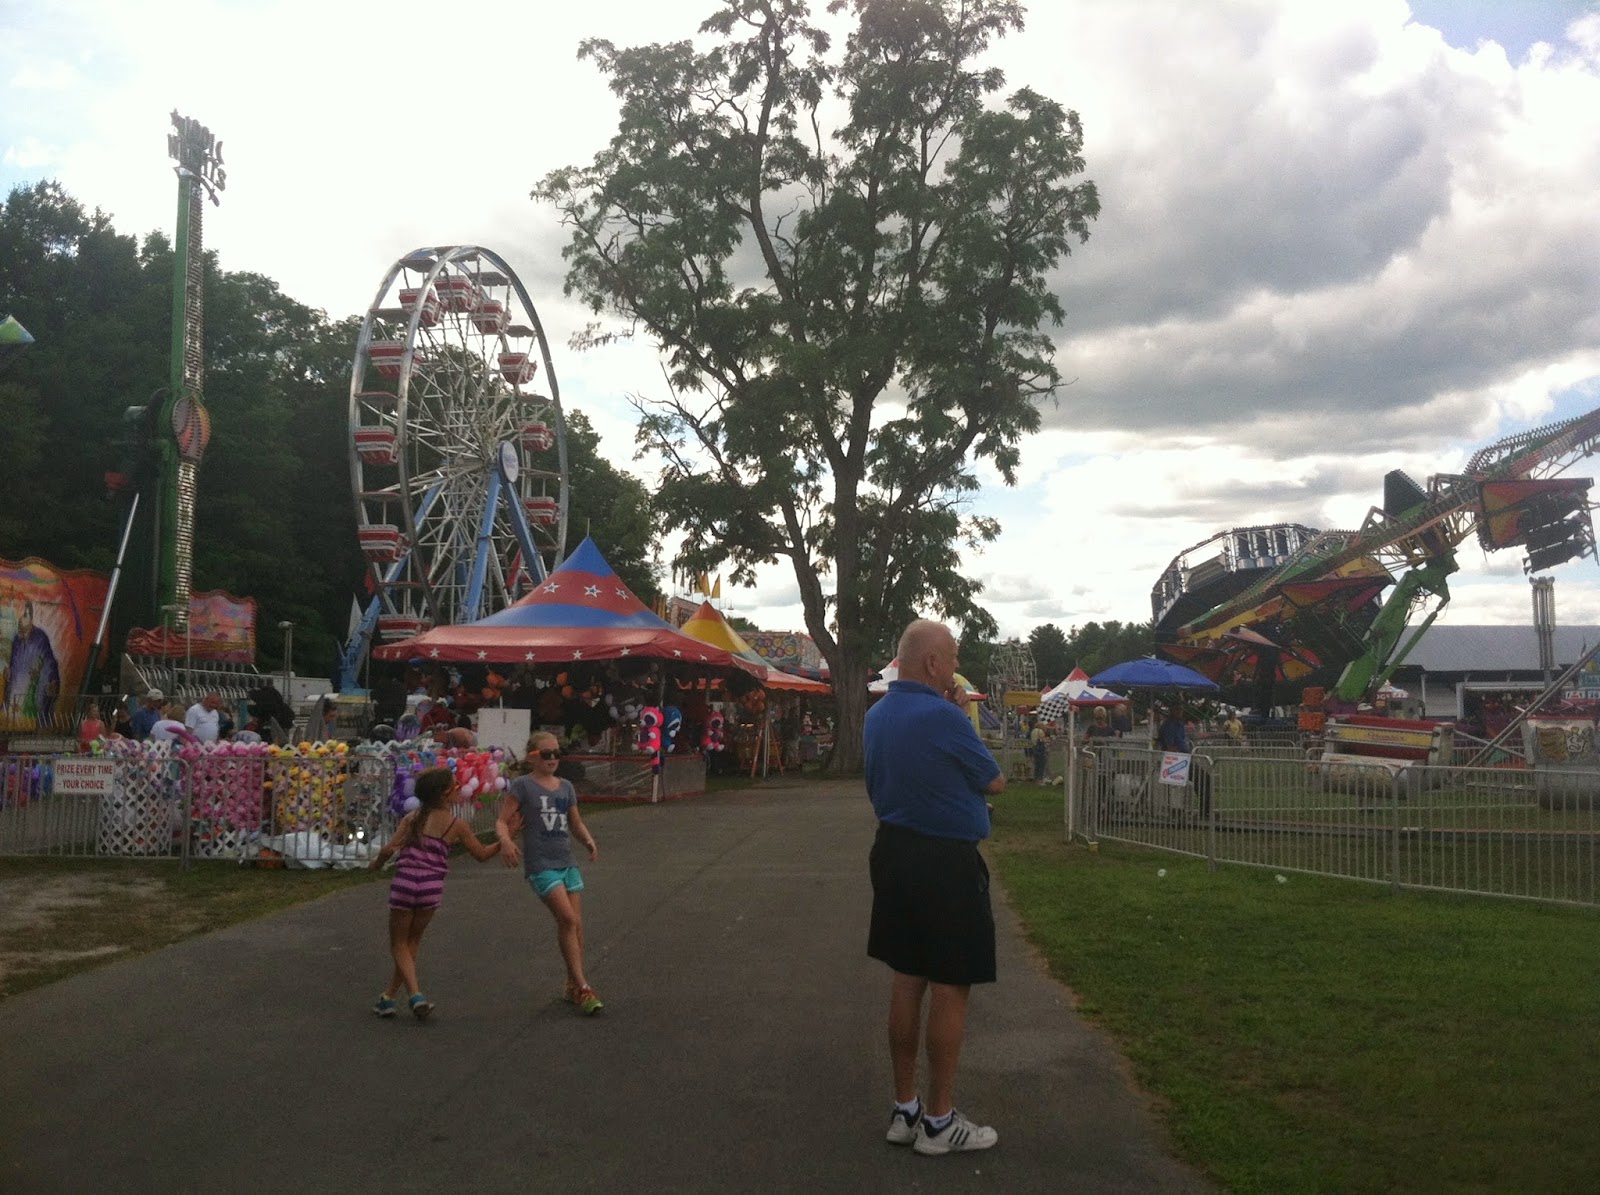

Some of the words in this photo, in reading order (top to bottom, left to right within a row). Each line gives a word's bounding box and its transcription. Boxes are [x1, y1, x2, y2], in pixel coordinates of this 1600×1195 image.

[57, 765, 74, 774] PRIZE
[76, 765, 95, 774] EVERY
[98, 765, 112, 774] TIME
[63, 780, 79, 788] YOUR
[81, 780, 104, 789] CHOICE
